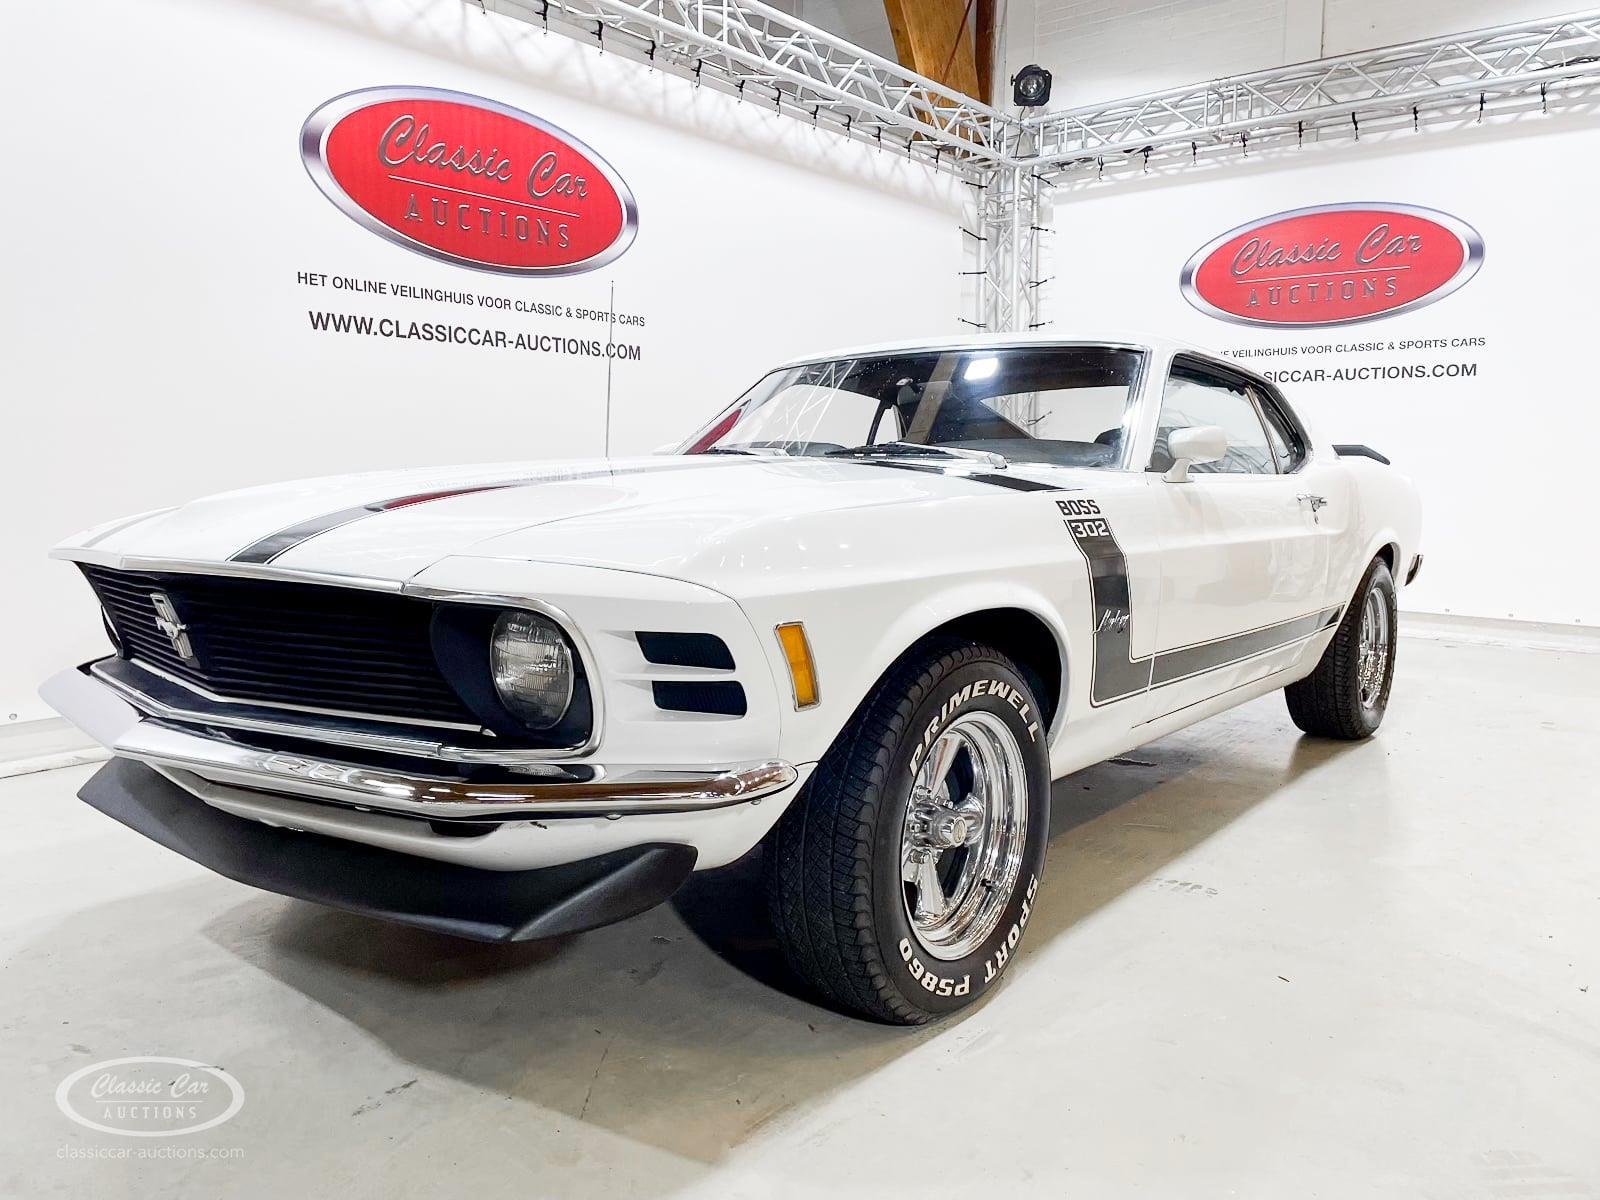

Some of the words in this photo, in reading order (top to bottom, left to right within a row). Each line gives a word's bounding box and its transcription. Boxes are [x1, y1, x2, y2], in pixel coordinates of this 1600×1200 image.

[378, 114, 513, 181] Classic
[527, 151, 590, 199] Car
[404, 193, 571, 249] AUCTIONS
[1231, 237, 1342, 277] Classic
[1355, 223, 1423, 265] Car
[297, 271, 328, 287] HET
[332, 276, 387, 295] ONLINE
[390, 283, 474, 306] VEILINGHUIS
[477, 295, 512, 310] VOOR
[515, 300, 563, 317] CLASSIC
[565, 307, 573, 318] &
[575, 308, 617, 324] SPORTS
[618, 314, 646, 327] CARS
[1245, 276, 1399, 307] AUCTIONS
[308, 310, 642, 361] WWW.CLASSICCAR-AUCTIONS.COM
[1232, 346, 1298, 358] VEILINGHUIS
[1300, 345, 1332, 354] VOOR
[1335, 342, 1384, 353] CLASSIC
[1387, 342, 1395, 351] &
[1399, 339, 1448, 350] SPORTS
[1451, 337, 1486, 348] CARS
[1056, 500, 1101, 515] BOSS
[1071, 521, 1110, 537] 302
[909, 679, 1040, 777] PRIMEWELL
[984, 873, 1038, 984] SPORT
[899, 938, 971, 997] PS860
